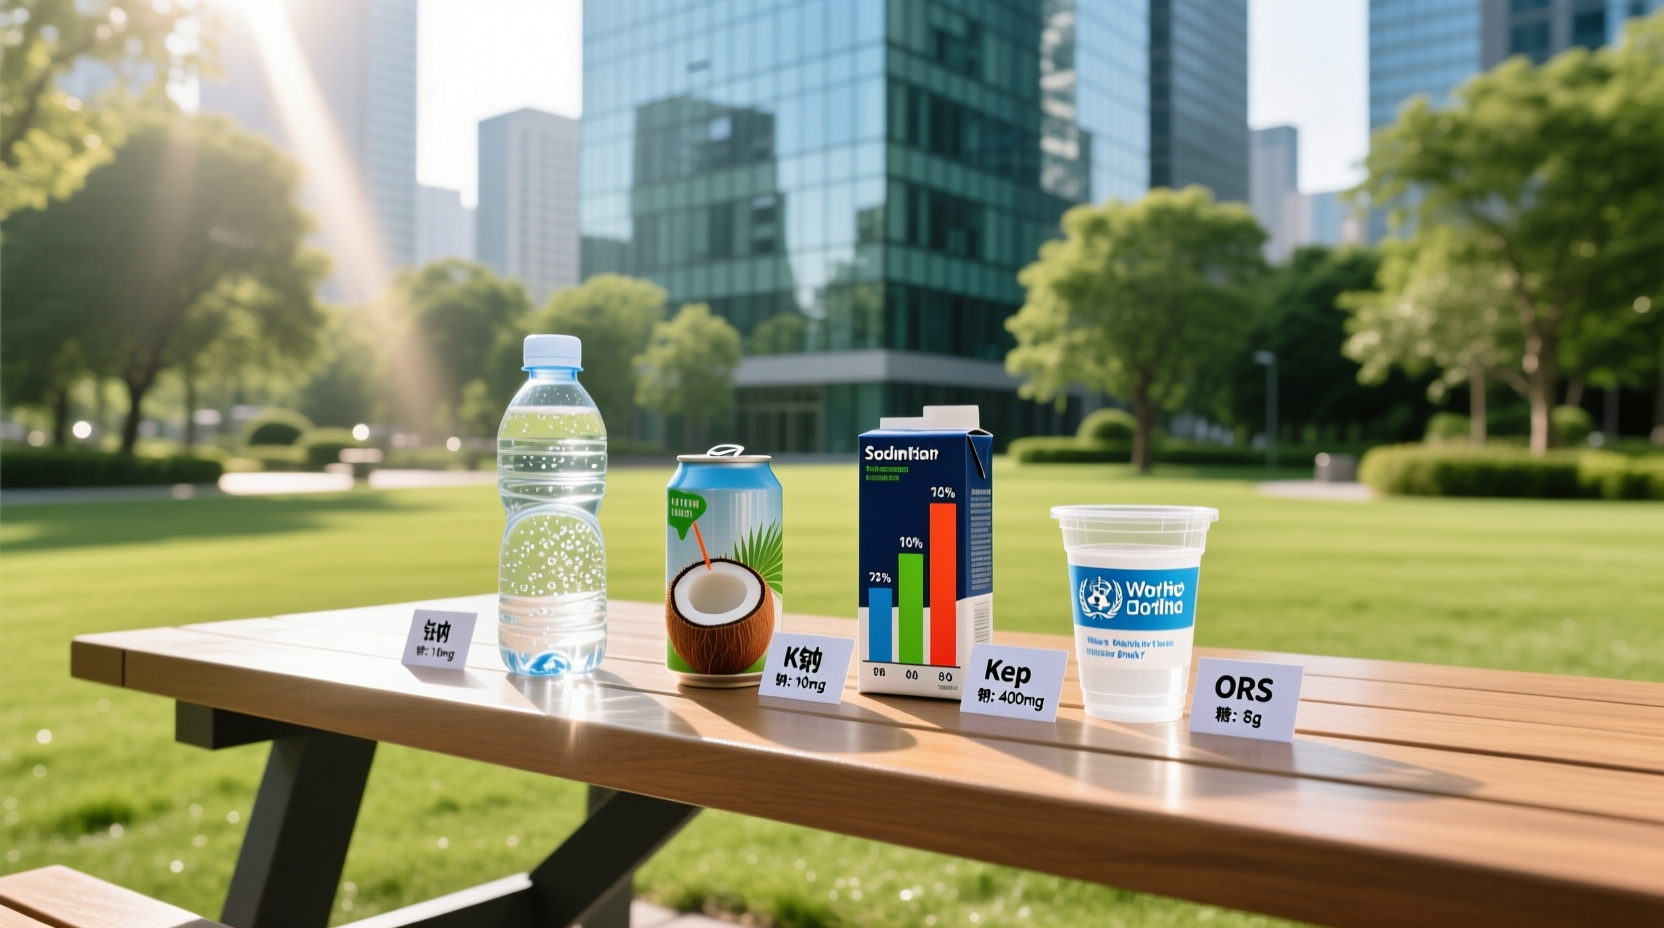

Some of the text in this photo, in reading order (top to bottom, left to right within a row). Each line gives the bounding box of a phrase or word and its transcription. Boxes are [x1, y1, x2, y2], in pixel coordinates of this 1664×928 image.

[985, 659, 1031, 688] Kep
[999, 690, 1044, 711] 400mg
[1215, 675, 1273, 702] ORS
